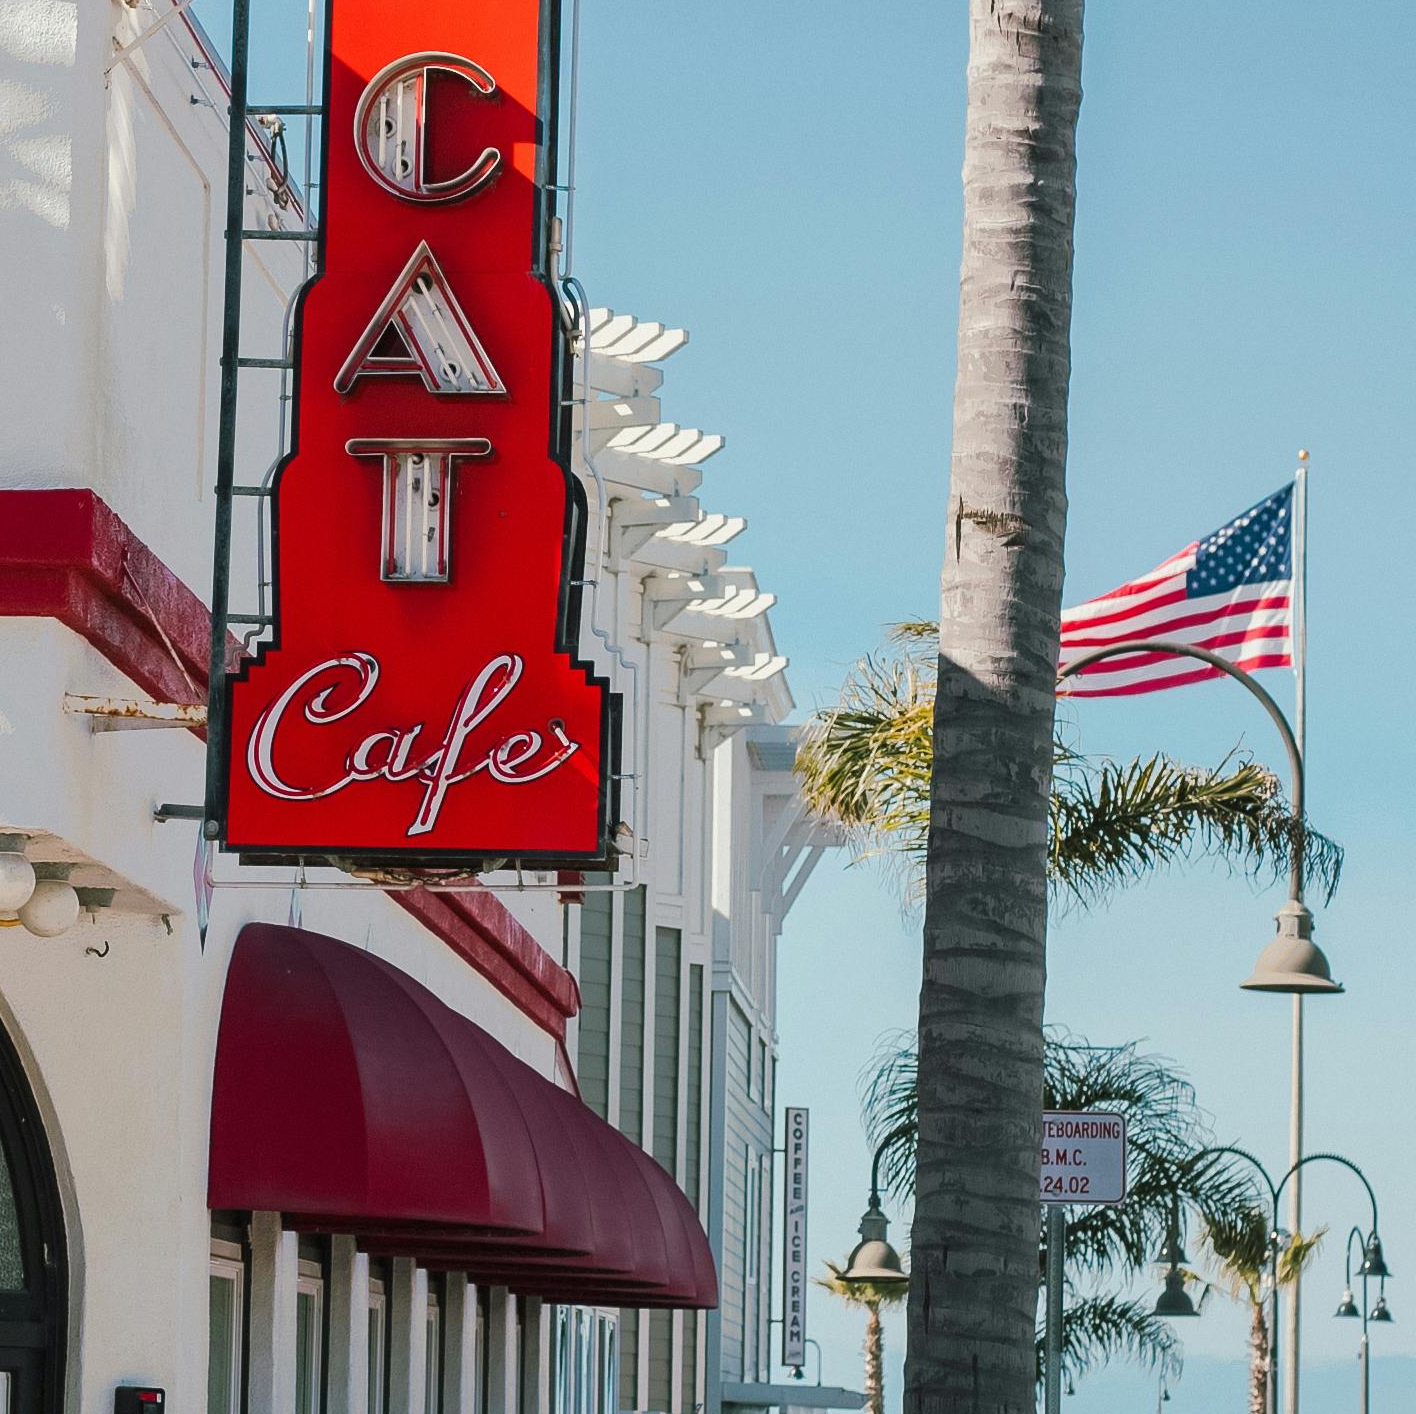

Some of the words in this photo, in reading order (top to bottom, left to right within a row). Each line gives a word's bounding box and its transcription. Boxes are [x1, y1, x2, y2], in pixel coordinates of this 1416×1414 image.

[333, 50, 508, 584] CAT
[245, 650, 581, 837] Cafe
[792, 1112, 803, 1200] COFFEE
[1041, 1148, 1087, 1166] B.M.C.
[791, 1220, 801, 1263] ICE
[789, 1270, 801, 1343] CREAM
